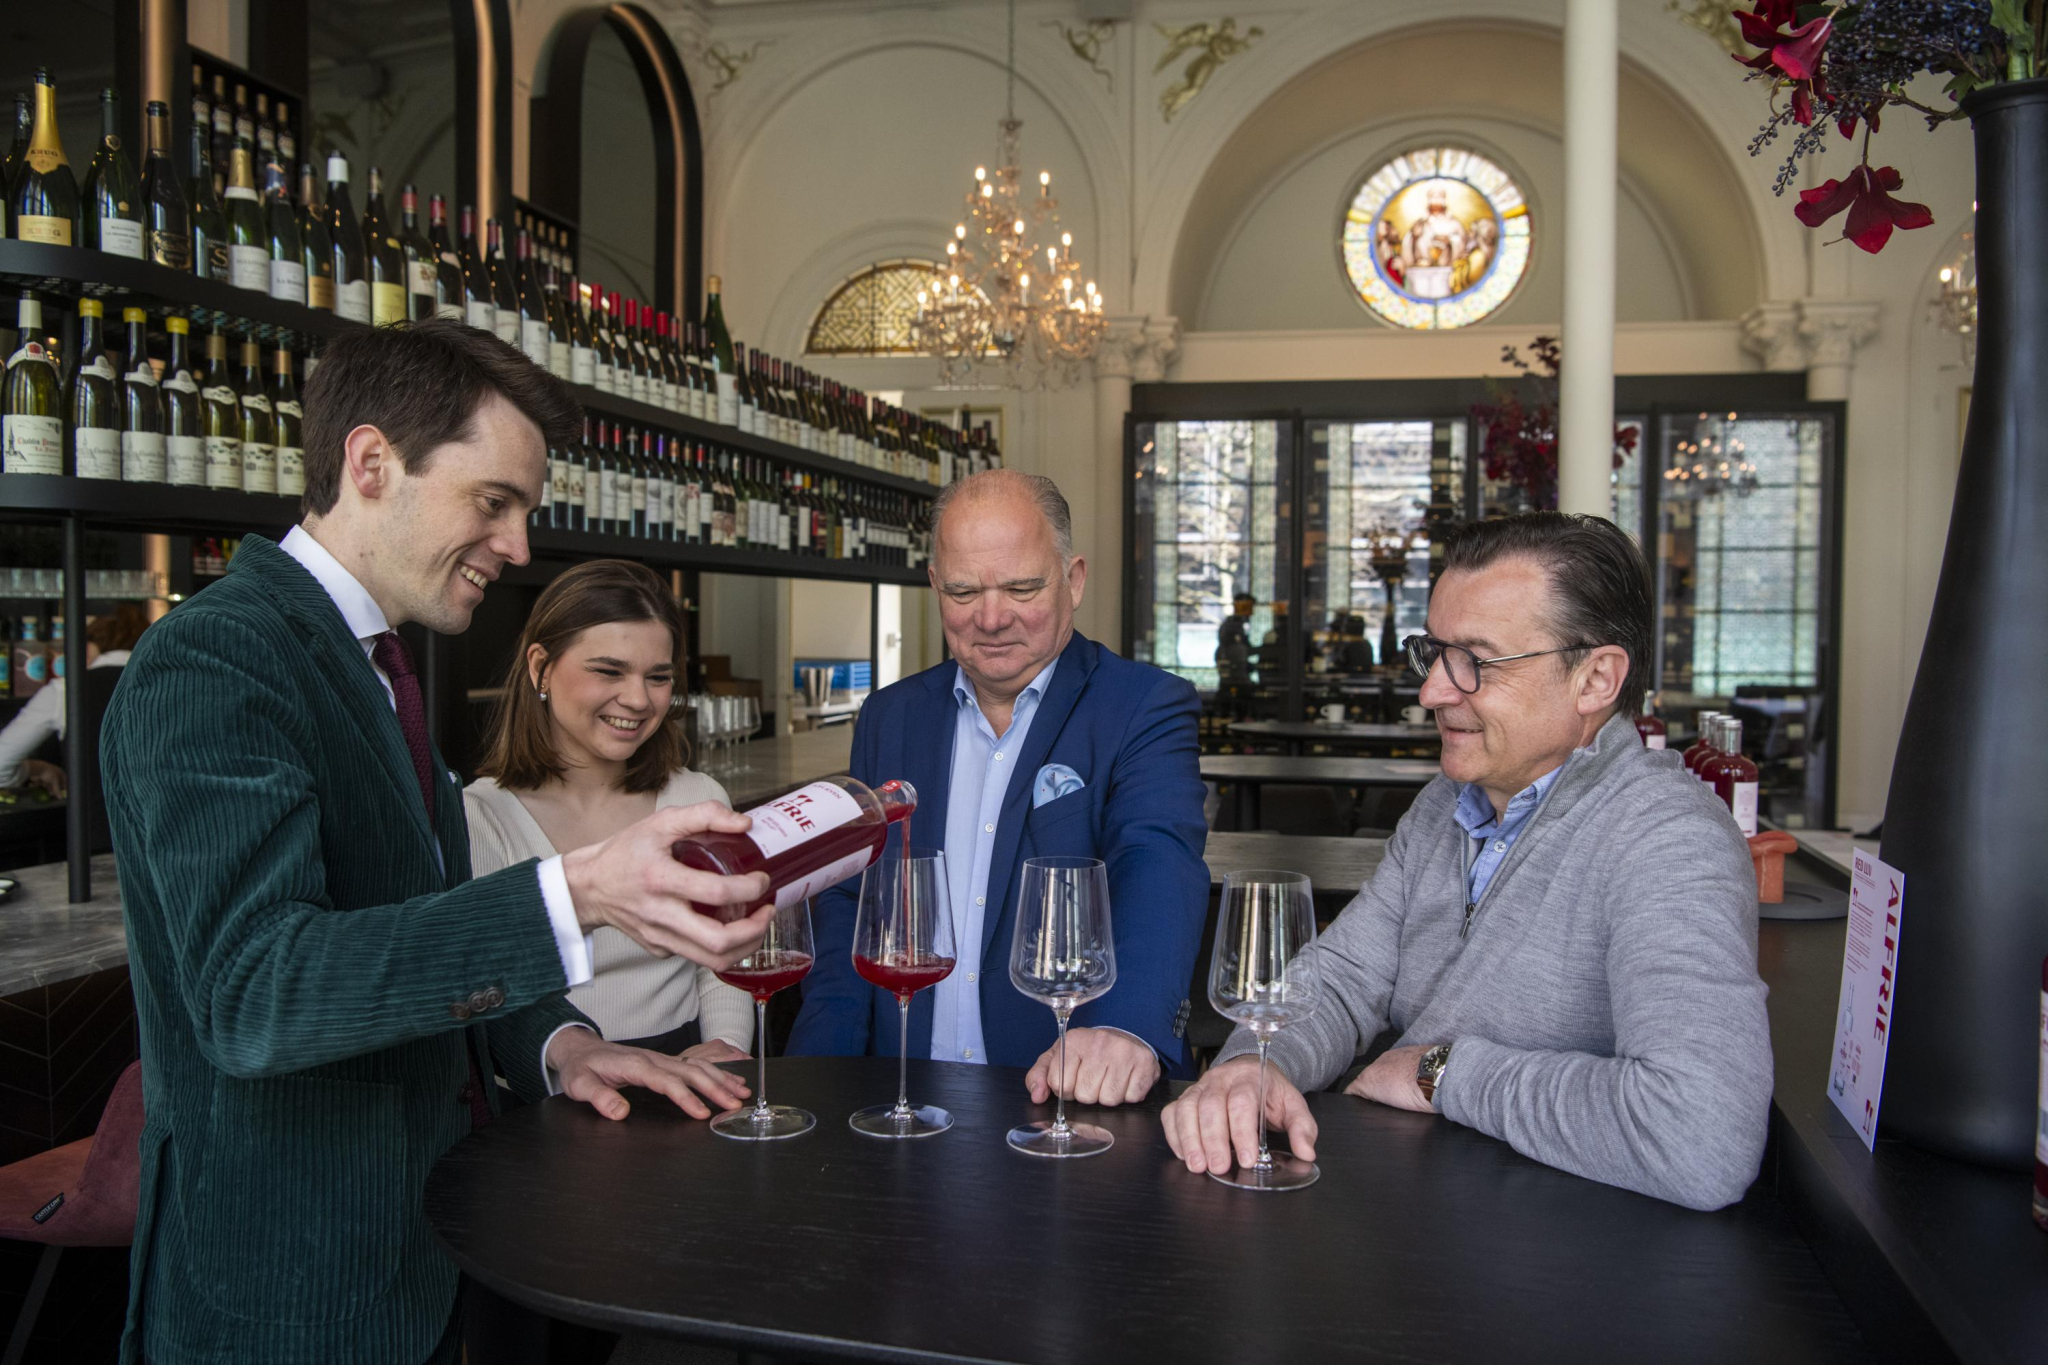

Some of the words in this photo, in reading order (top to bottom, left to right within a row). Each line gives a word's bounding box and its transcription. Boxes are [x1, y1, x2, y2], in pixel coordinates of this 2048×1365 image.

[30, 149, 59, 157] KRUG
[26, 227, 61, 237] KRUG
[1855, 857, 1864, 872] RED
[1873, 877, 1900, 1046] ALFRIE
